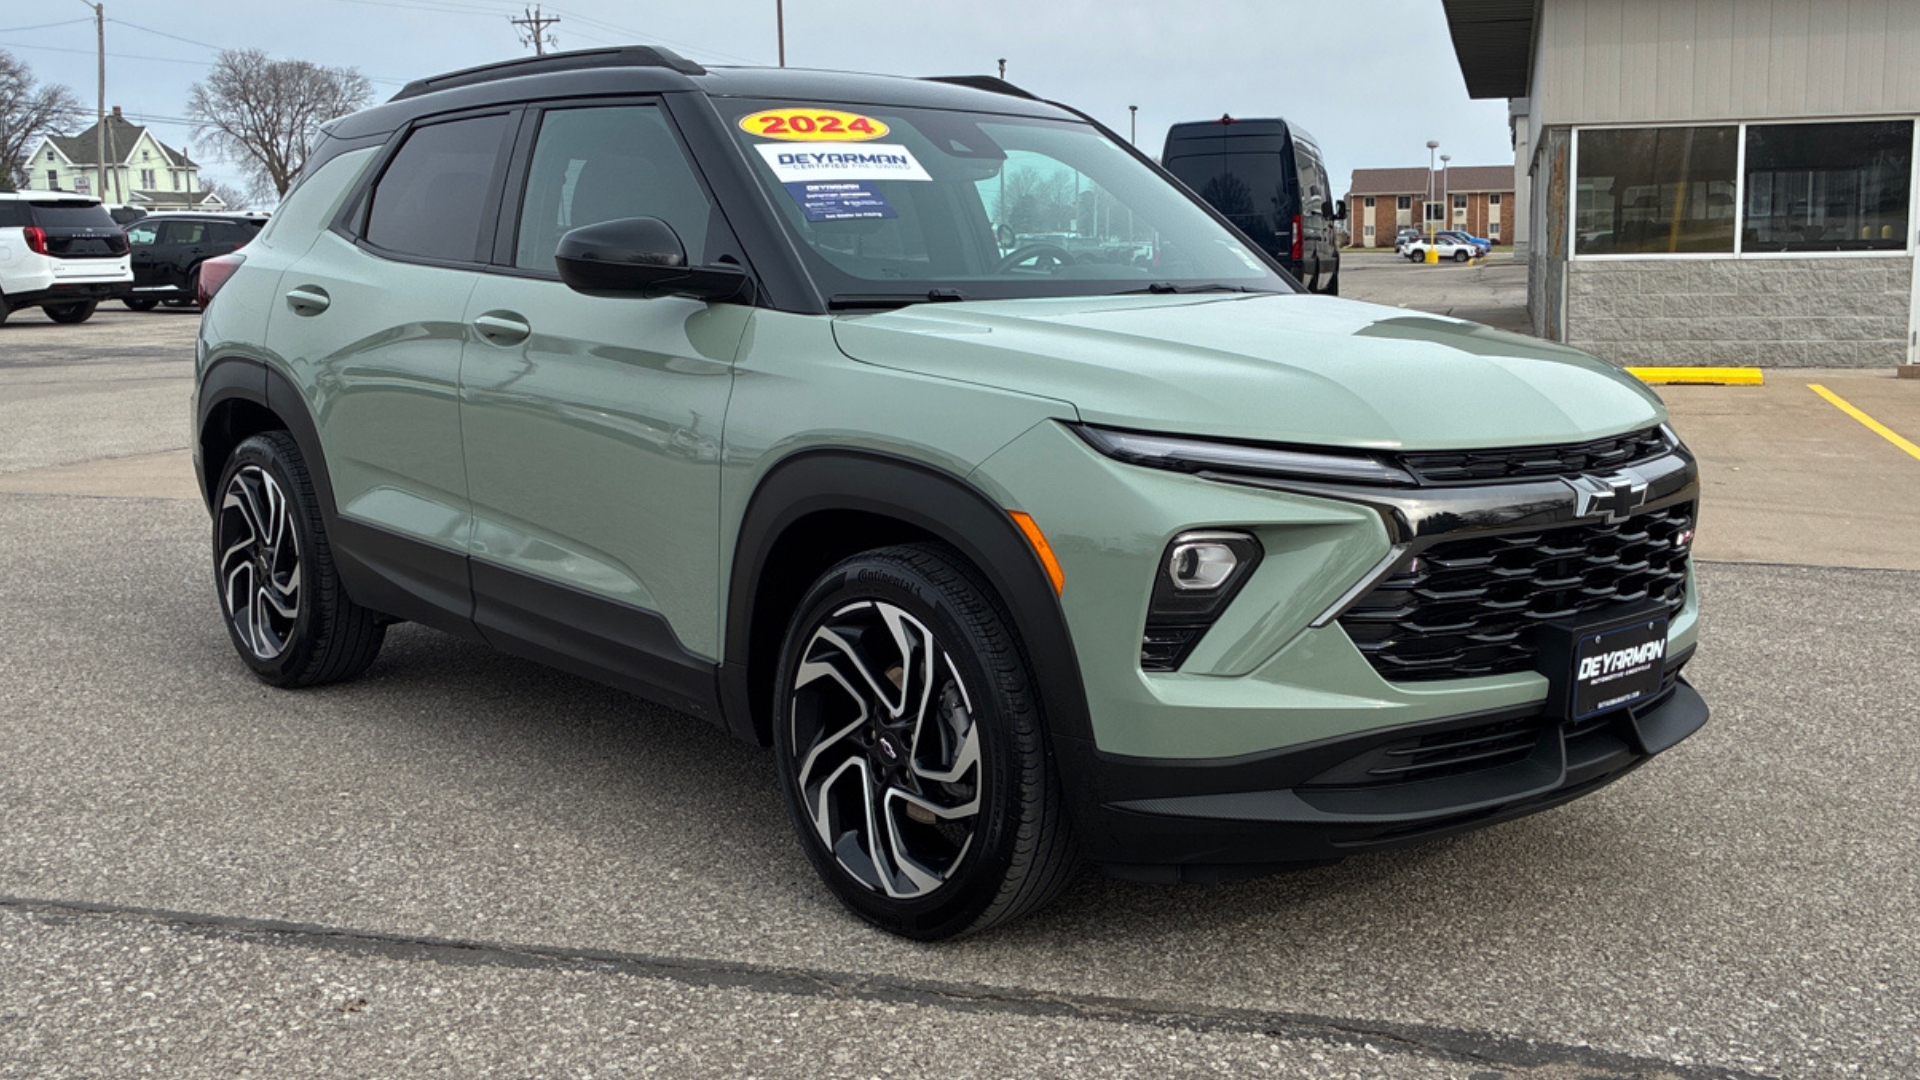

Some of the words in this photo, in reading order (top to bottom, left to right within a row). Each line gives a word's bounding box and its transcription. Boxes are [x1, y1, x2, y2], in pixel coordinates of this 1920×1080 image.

[759, 115, 876, 134] 2024
[777, 153, 908, 165] DEYARMAN
[793, 162, 848, 170] CERTIFIED
[857, 568, 916, 594] Continental
[1577, 638, 1666, 681] DEYARMAN
